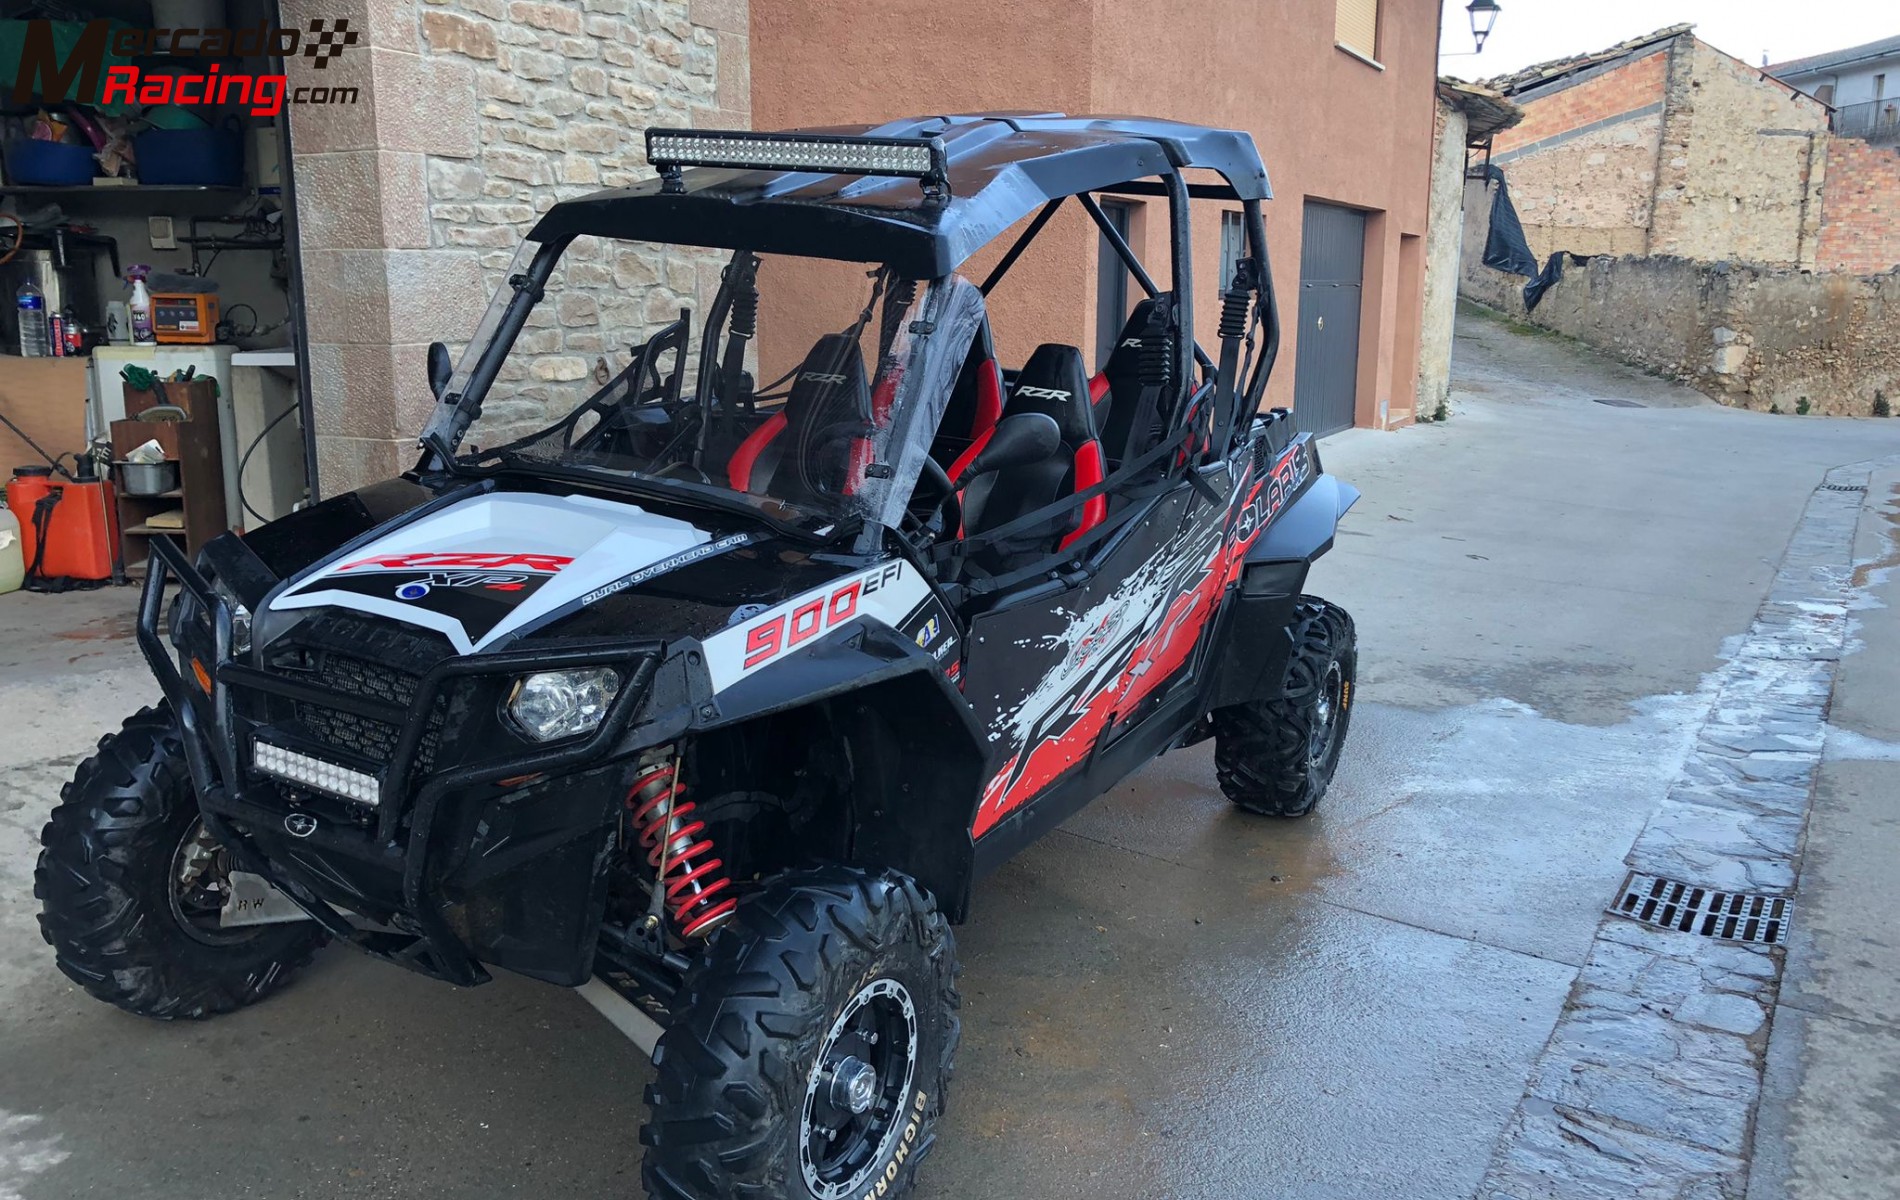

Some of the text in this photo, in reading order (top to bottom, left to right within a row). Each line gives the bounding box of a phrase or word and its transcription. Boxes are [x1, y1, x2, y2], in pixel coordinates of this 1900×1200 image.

[1015, 386, 1072, 402] RZR
[1226, 443, 1310, 560] POLARIS
[582, 533, 748, 606] DUAL OVERHEAD CAM
[743, 561, 902, 670] 900 EFI
